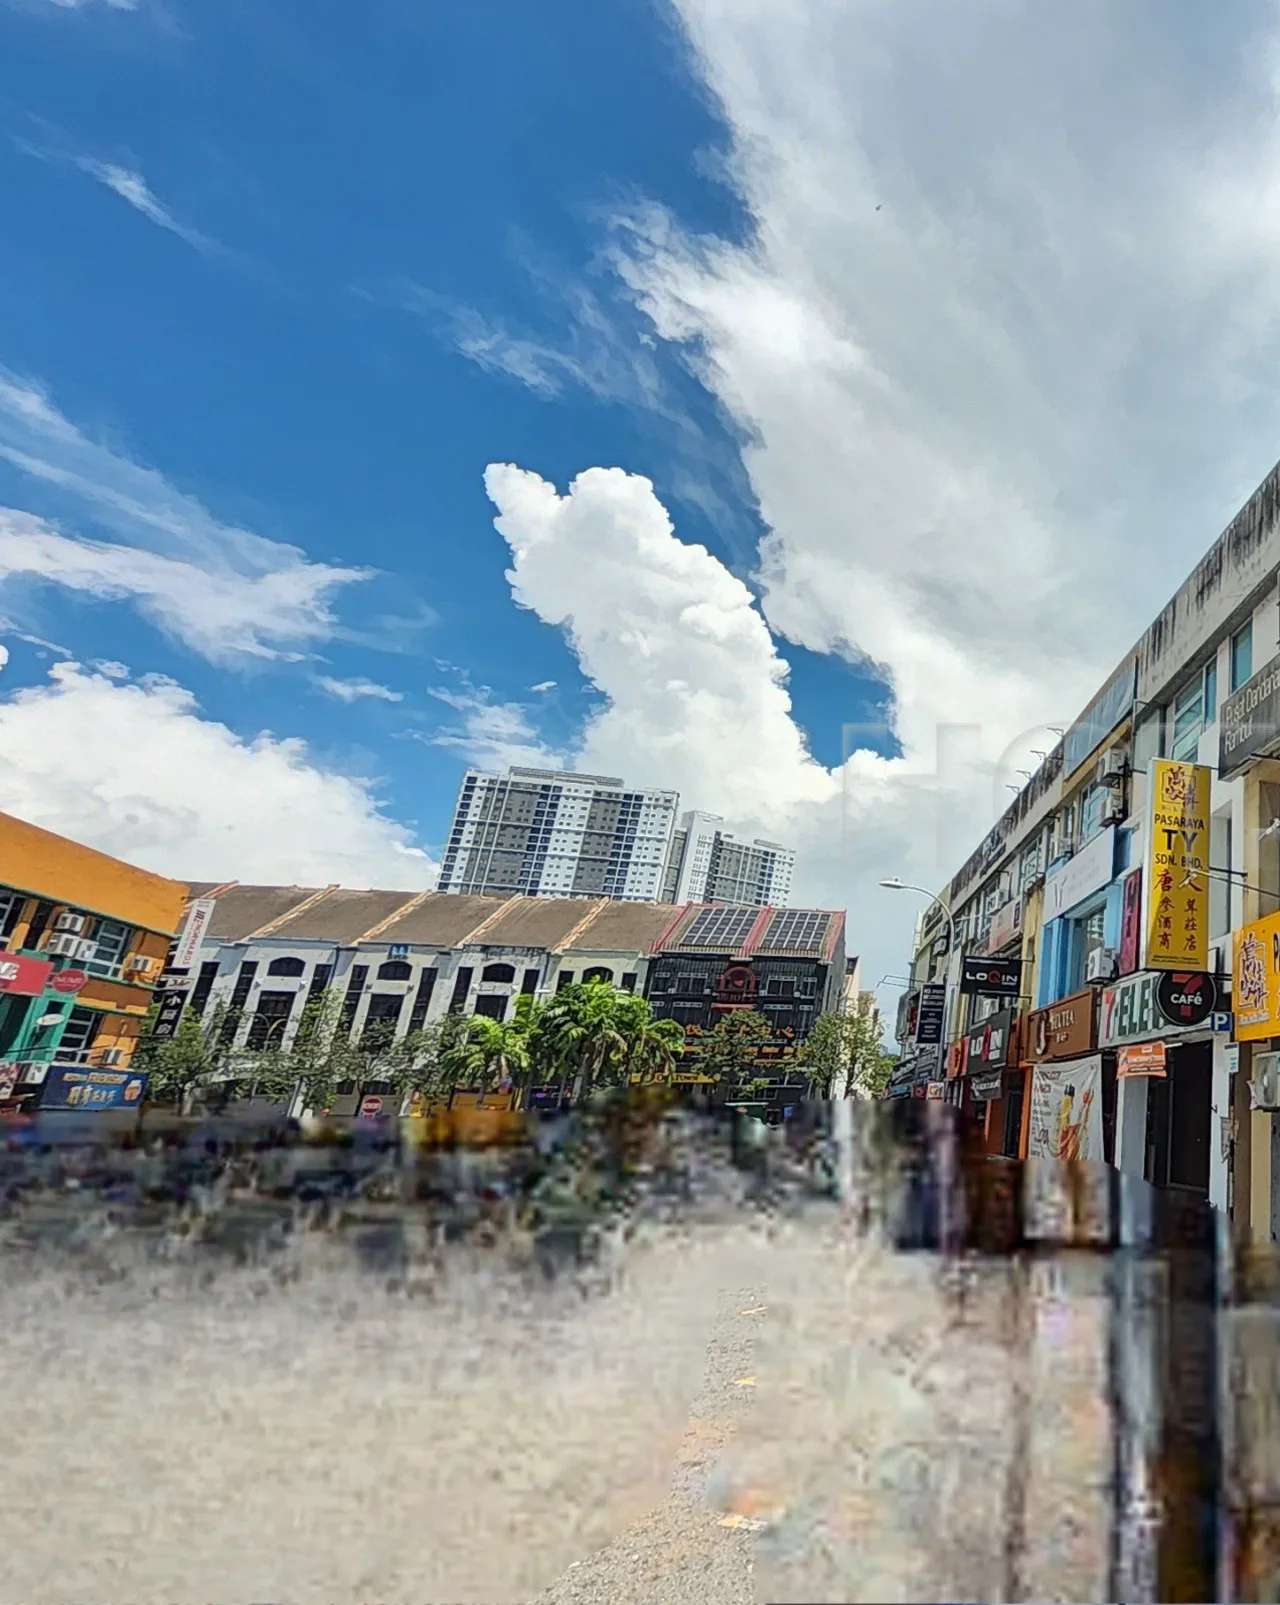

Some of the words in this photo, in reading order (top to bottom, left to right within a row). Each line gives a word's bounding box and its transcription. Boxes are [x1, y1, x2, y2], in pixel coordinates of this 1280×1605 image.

[1154, 813, 1205, 830] PASARAYA
[1162, 828, 1198, 852] TY
[1155, 852, 1178, 867] SDN.
[1181, 854, 1204, 870] BHD.
[1103, 976, 1166, 1040] 7-ELE
[1213, 1012, 1229, 1031] P
